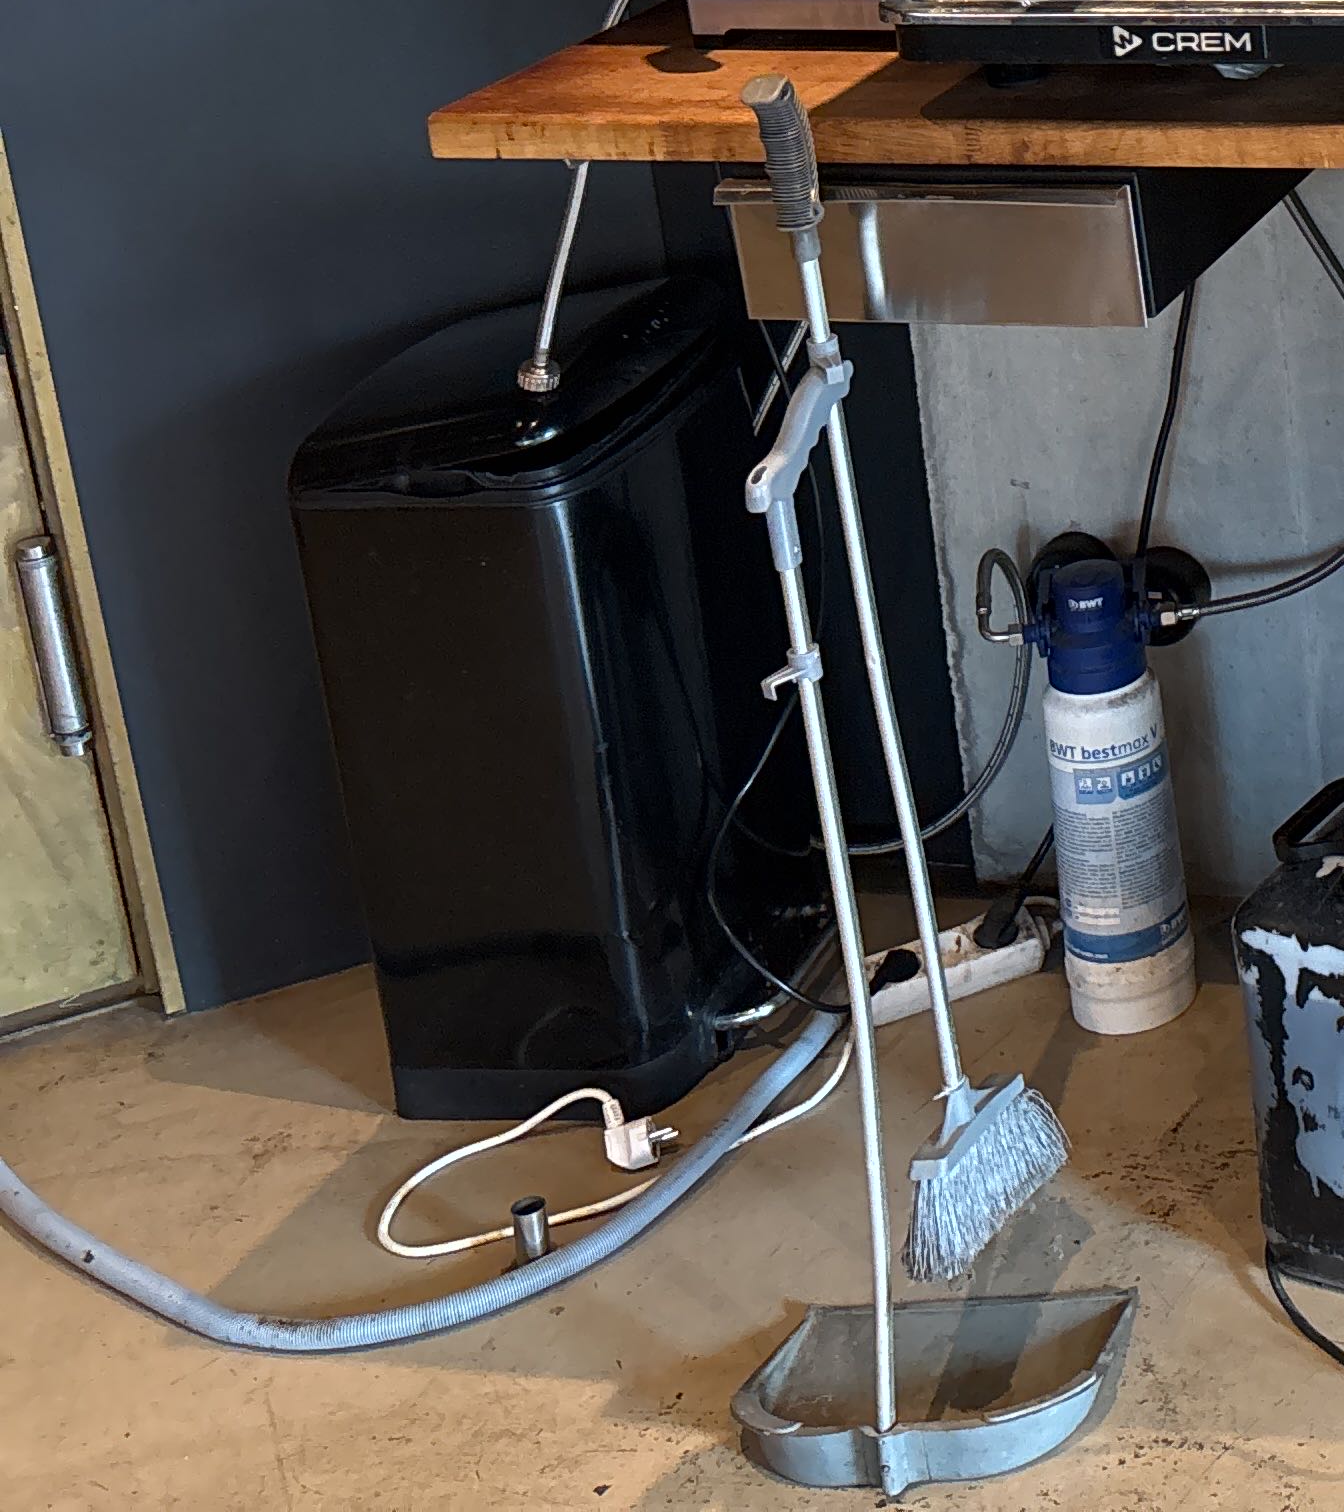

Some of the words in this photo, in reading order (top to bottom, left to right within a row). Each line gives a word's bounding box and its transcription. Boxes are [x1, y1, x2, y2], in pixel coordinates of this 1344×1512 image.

[1152, 31, 1252, 52] CREM
[1049, 738, 1077, 760] BWT
[1080, 734, 1150, 760] bestmax
